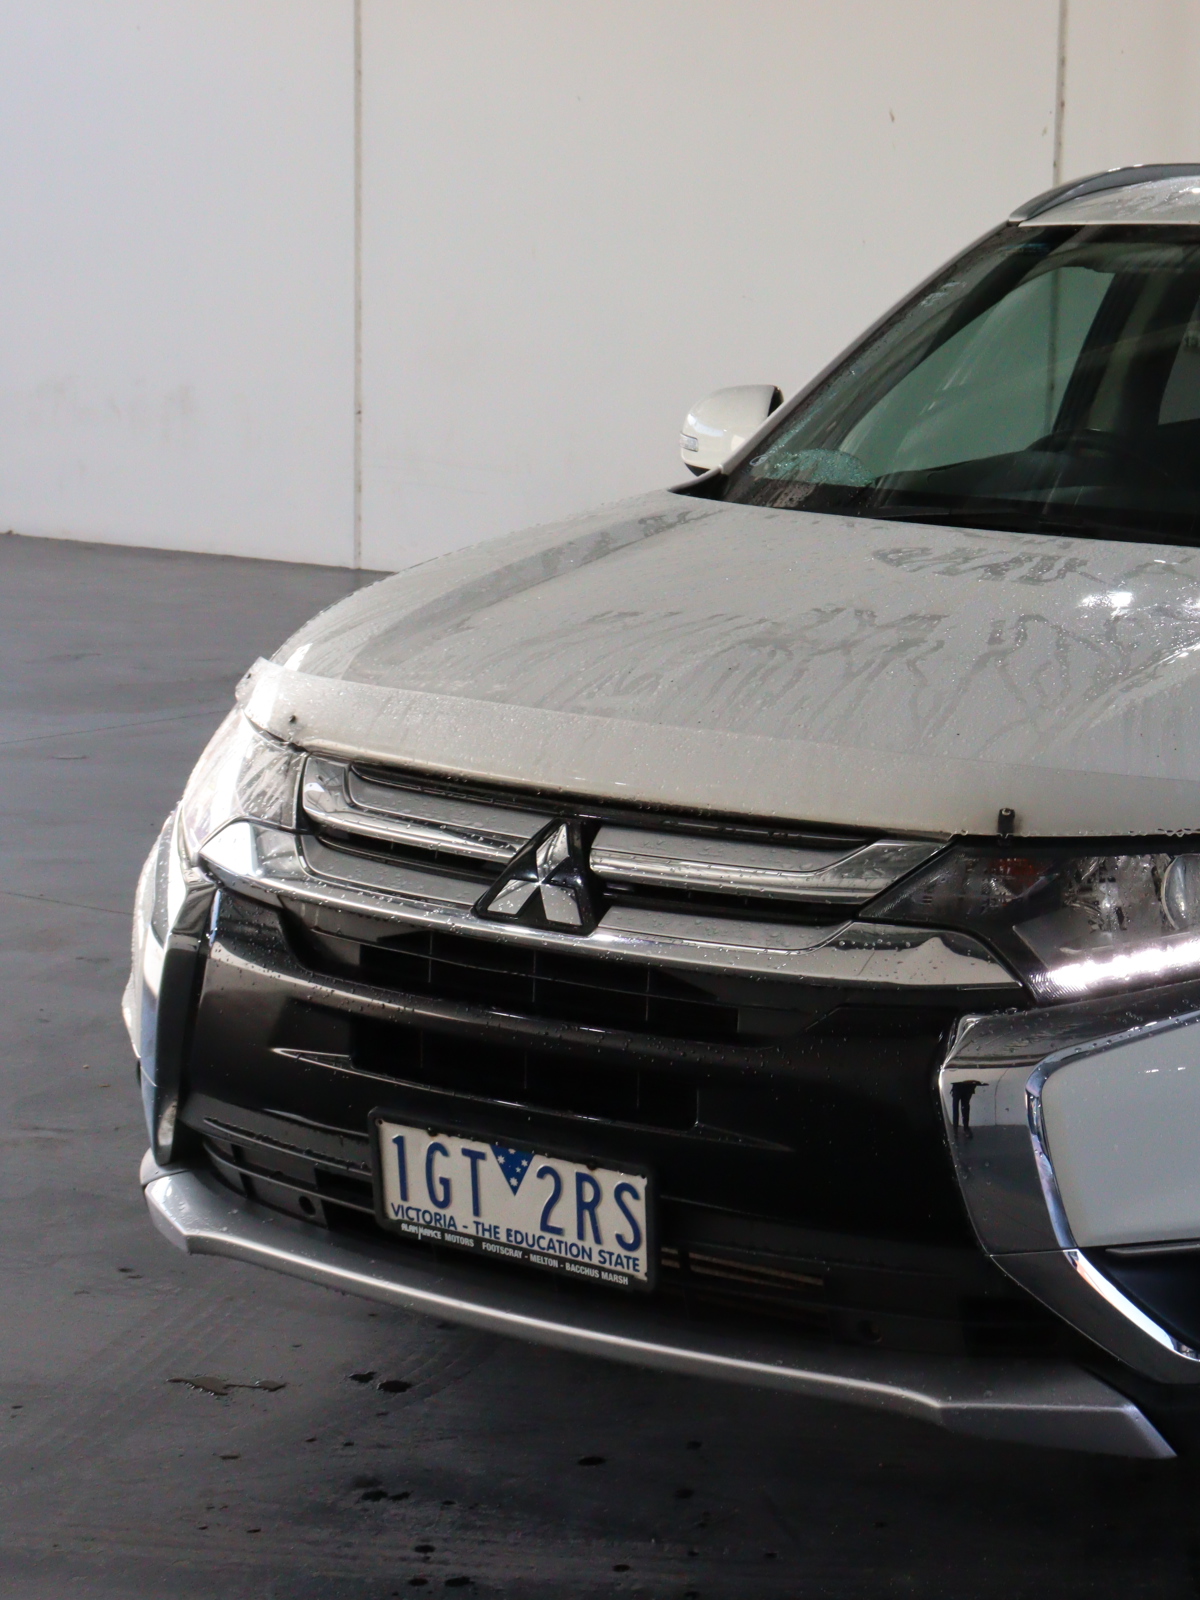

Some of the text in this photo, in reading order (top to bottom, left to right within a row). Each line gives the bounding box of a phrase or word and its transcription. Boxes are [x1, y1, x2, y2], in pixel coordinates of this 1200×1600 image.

[392, 1135, 642, 1252] 1GT 2RS
[391, 1202, 458, 1231] VICTORIA
[473, 1220, 501, 1241] THE
[506, 1227, 593, 1262] EDUCATION
[598, 1249, 641, 1273] STATE
[444, 1232, 475, 1247] MOTORS
[482, 1241, 523, 1259] FOOTSCRAY
[529, 1253, 559, 1268] MELTON
[565, 1262, 600, 1278] BACCHUS
[601, 1271, 629, 1285] MARSH
